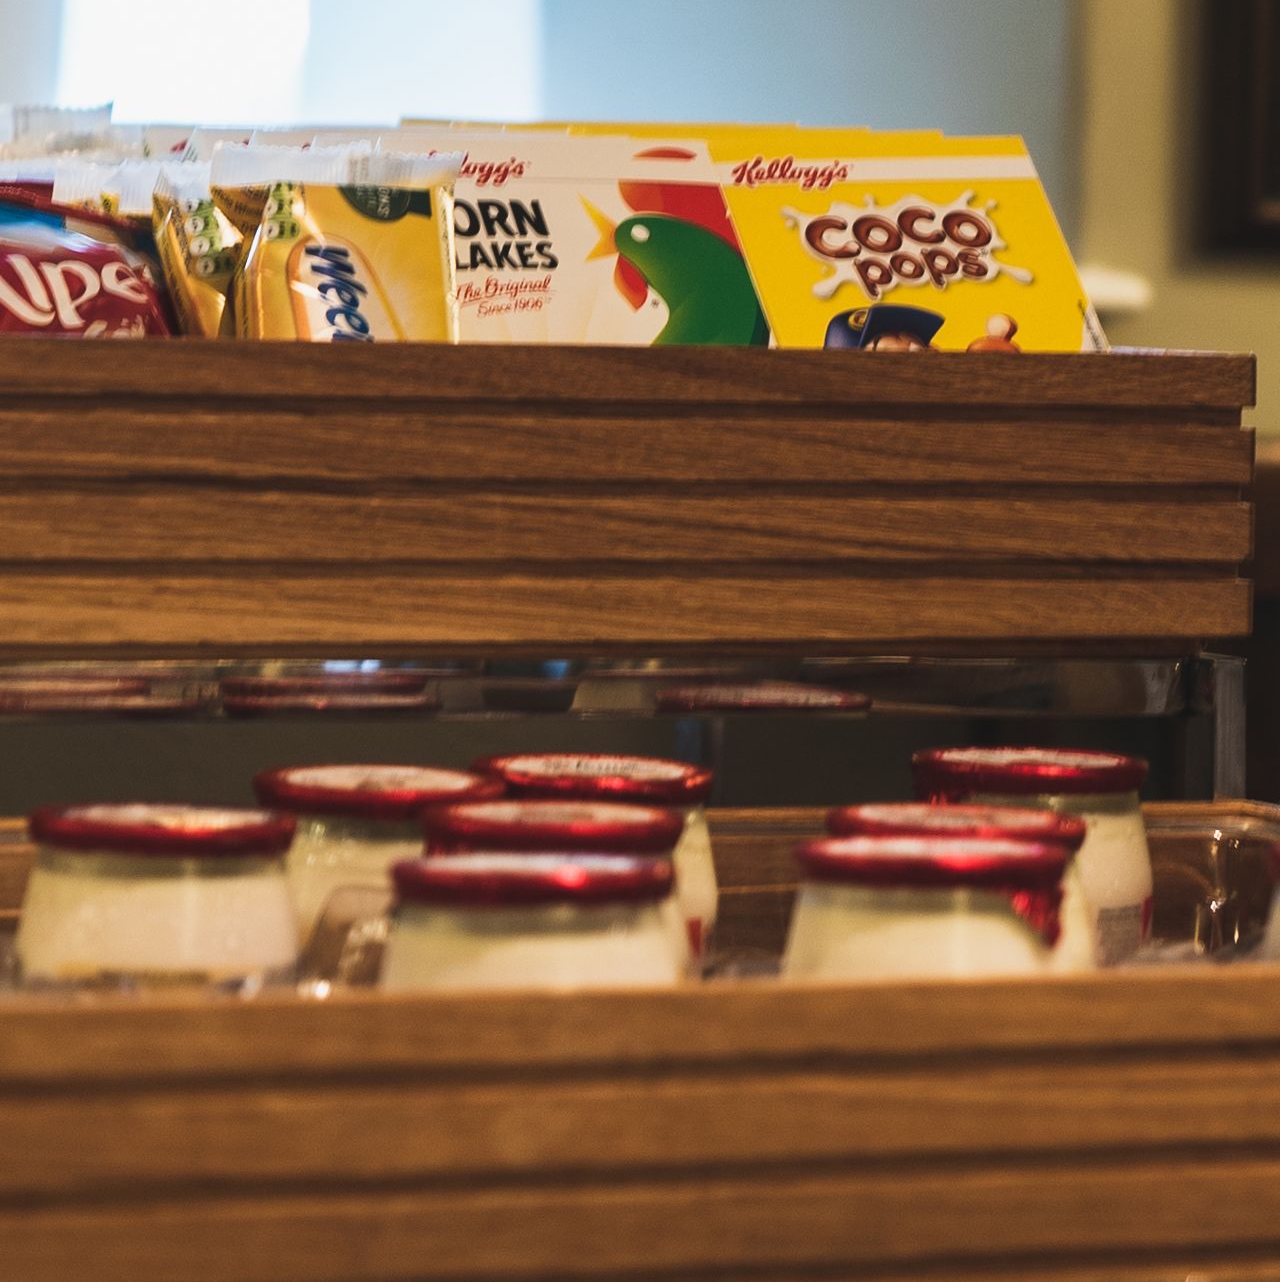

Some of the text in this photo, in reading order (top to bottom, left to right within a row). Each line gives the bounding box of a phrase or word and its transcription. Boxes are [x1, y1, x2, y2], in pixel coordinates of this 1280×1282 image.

[731, 155, 848, 190] Kellogg's
[454, 199, 551, 238] ORN
[455, 240, 560, 271] LAKES
[454, 273, 553, 301] The Original
[477, 300, 513, 318] Since
